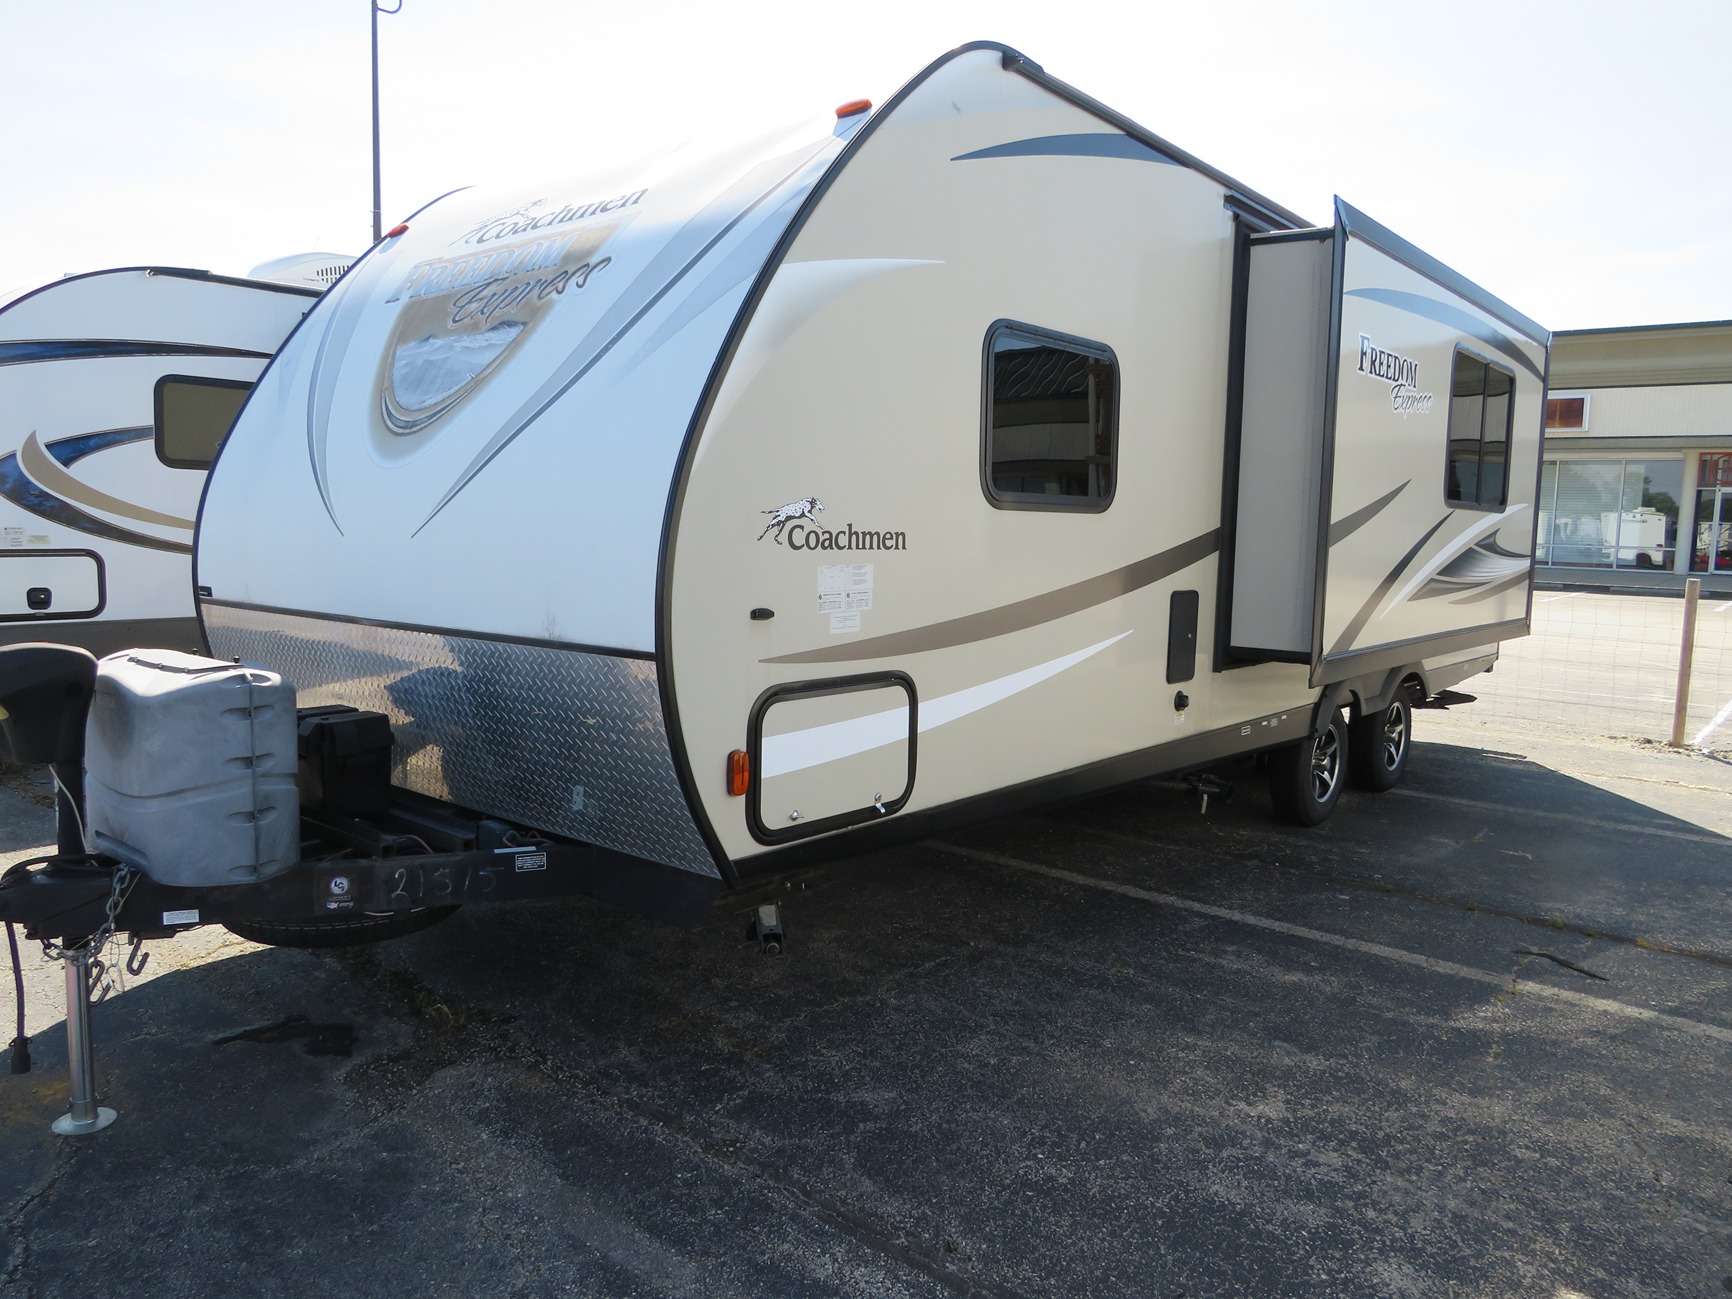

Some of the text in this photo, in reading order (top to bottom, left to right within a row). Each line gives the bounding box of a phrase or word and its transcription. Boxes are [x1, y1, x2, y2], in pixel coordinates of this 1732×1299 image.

[476, 188, 649, 245] Coachmen
[451, 255, 612, 324] Express
[1357, 334, 1418, 389] FREEDOM
[1390, 382, 1432, 418] Express
[787, 523, 907, 551] Coachmen
